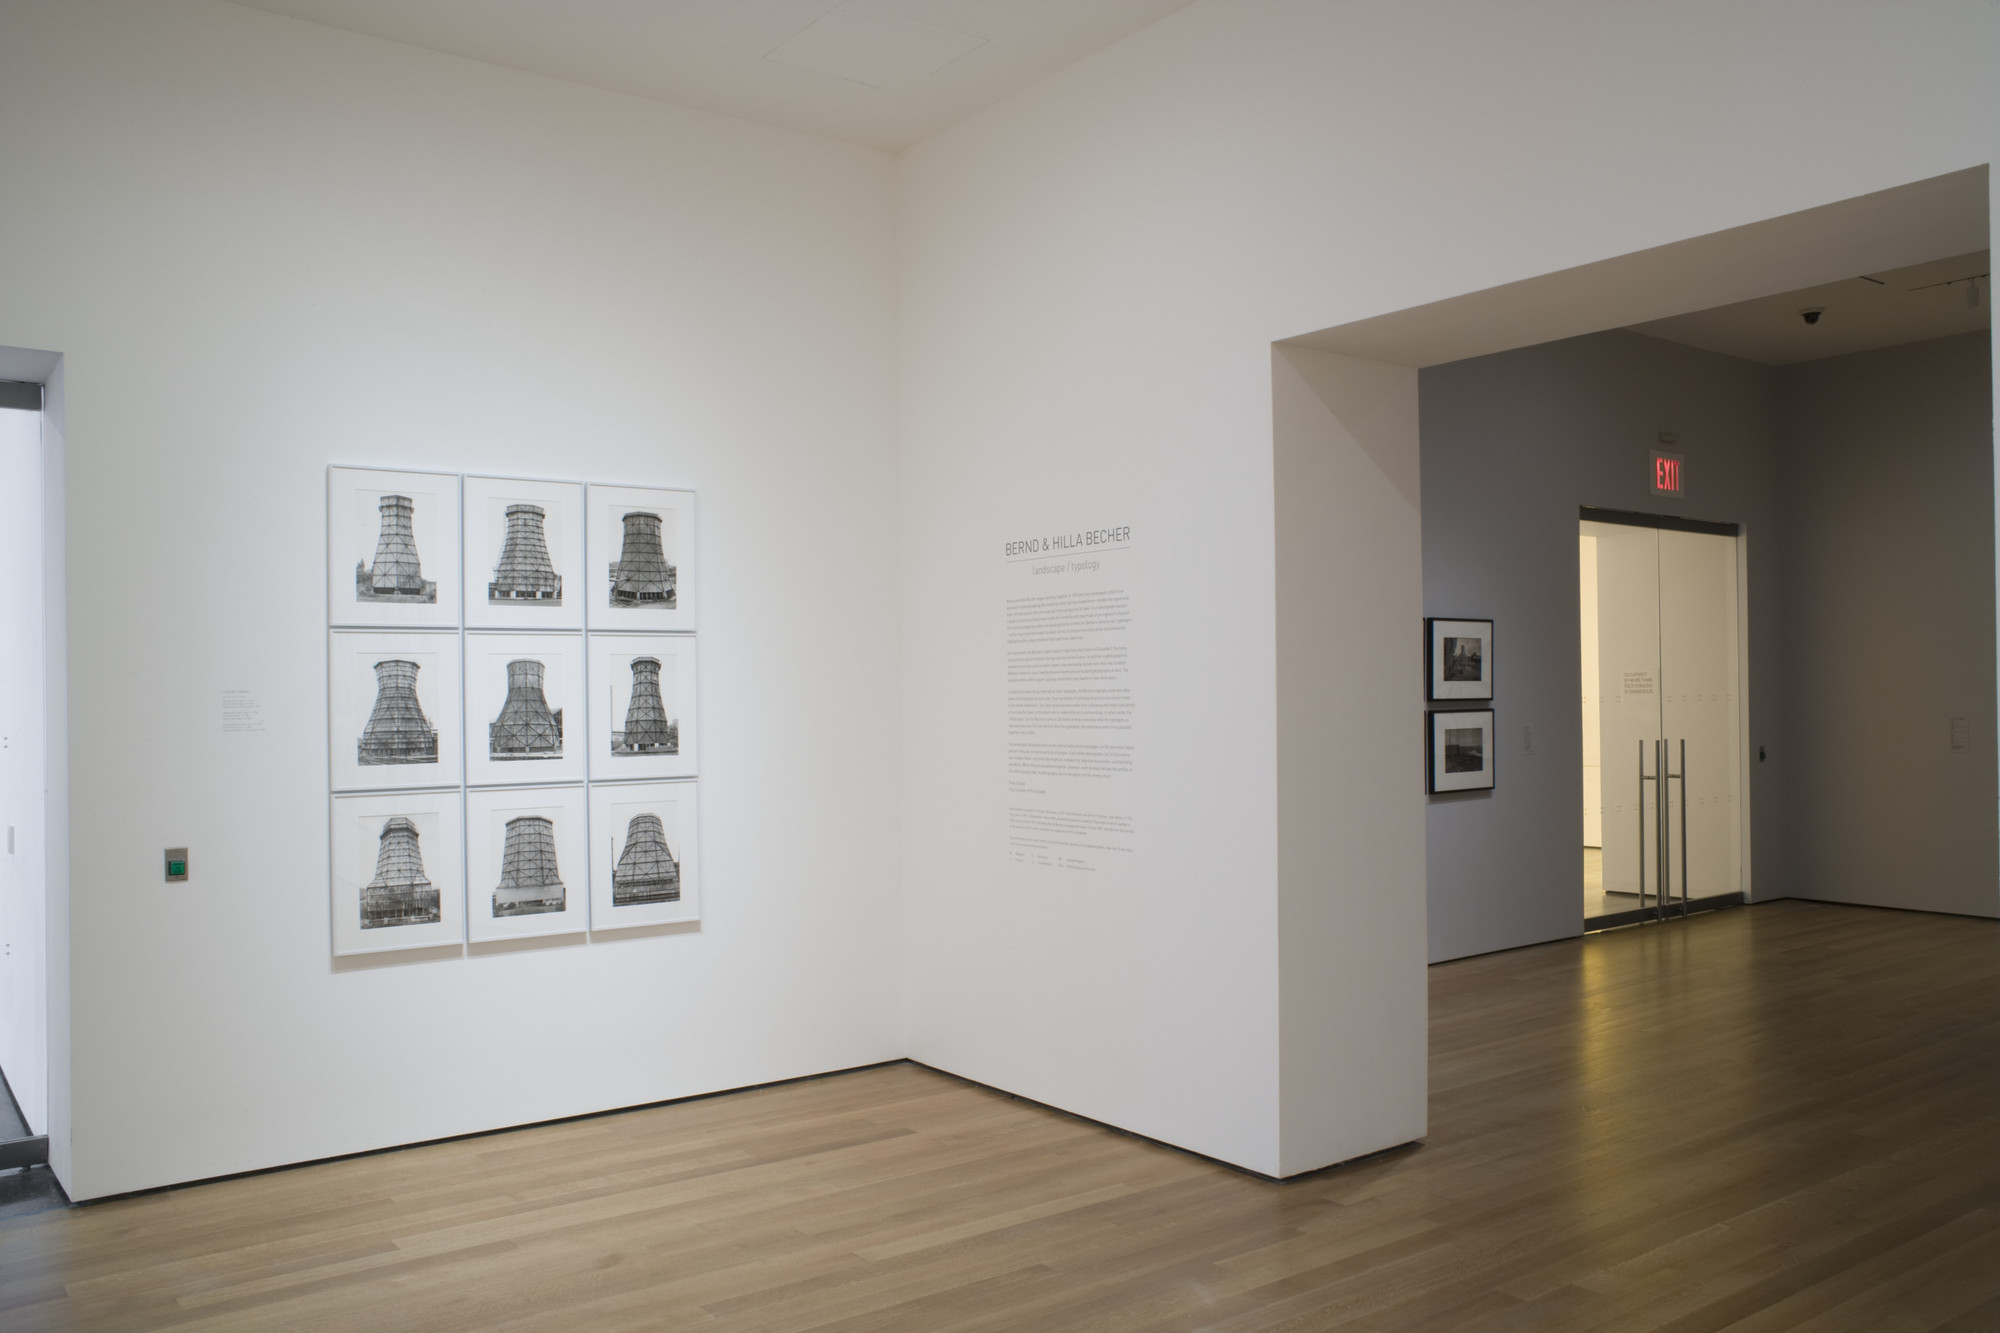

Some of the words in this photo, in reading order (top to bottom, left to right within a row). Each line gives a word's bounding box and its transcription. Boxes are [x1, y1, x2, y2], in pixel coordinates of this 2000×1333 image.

[1656, 457, 1680, 491] EXIT
[1005, 539, 1040, 556] BERND
[1042, 537, 1050, 551] &
[1052, 533, 1083, 550] HILLA
[1086, 526, 1131, 546] BECHER
[1032, 562, 1065, 575] landscape
[1071, 559, 1100, 572] typology
